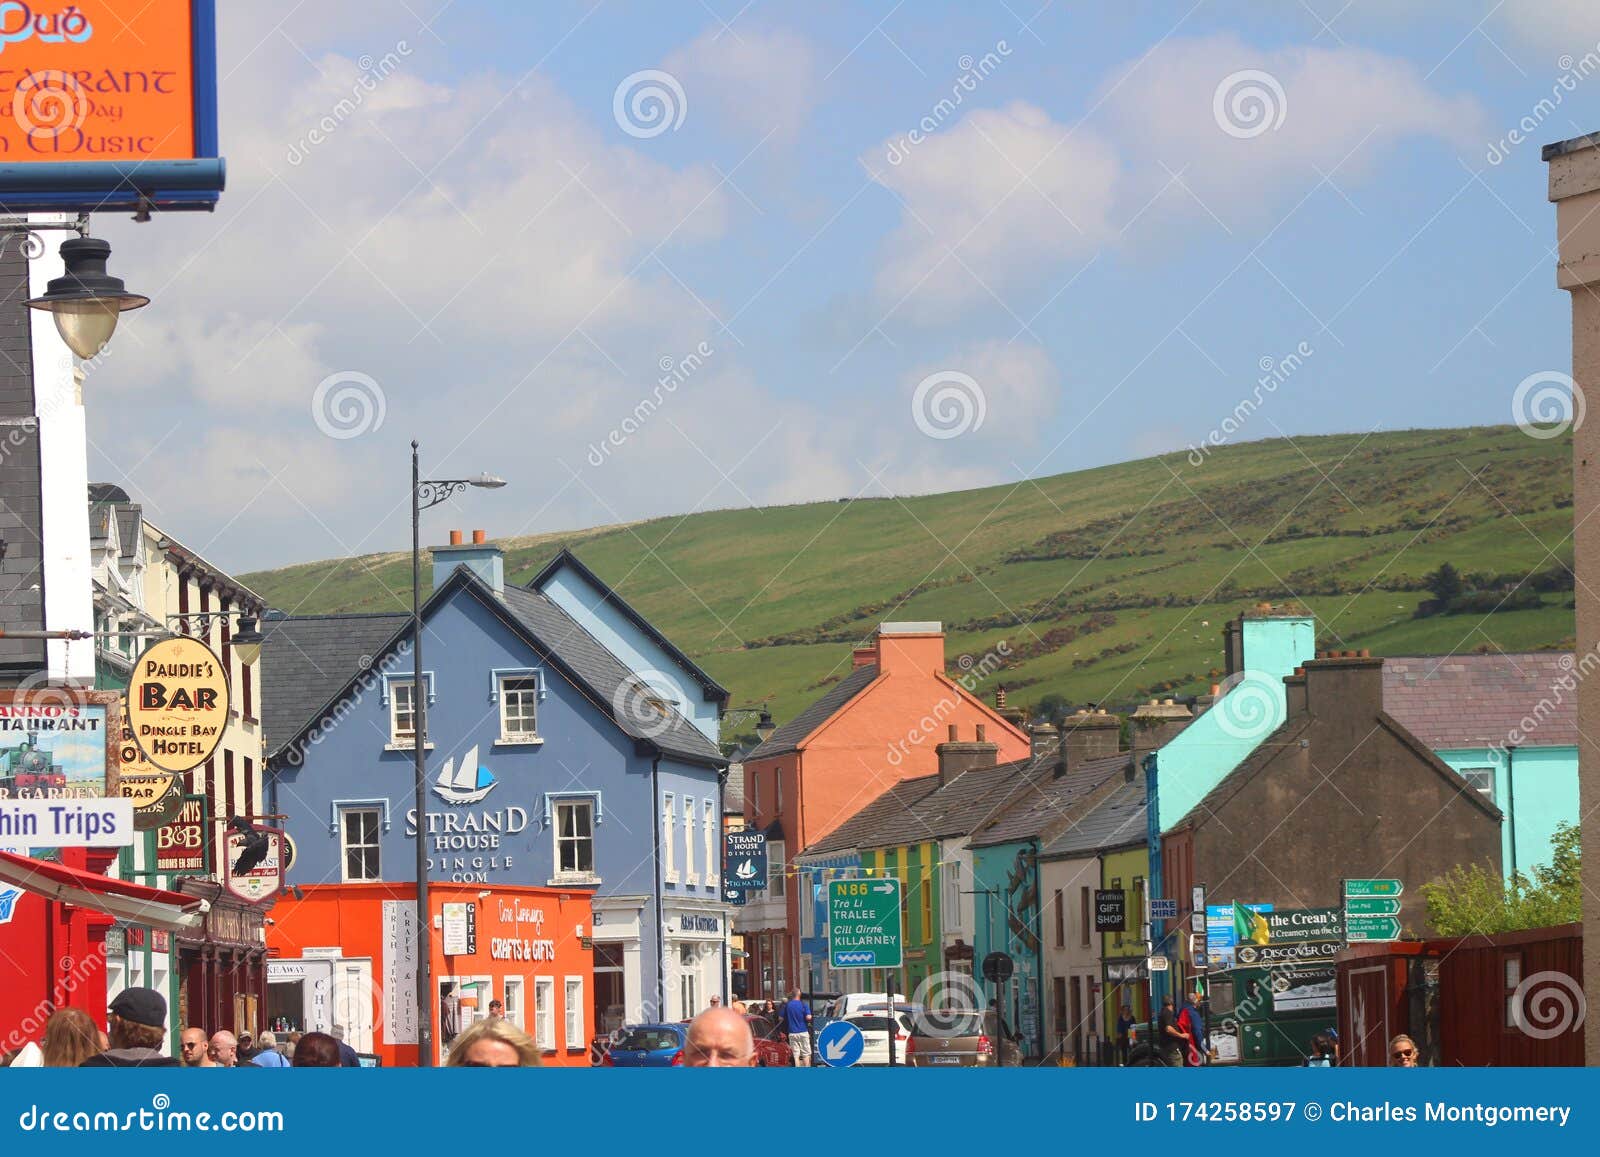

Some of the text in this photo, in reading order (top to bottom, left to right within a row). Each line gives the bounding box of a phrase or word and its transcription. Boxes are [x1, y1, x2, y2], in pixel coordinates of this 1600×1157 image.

[139, 682, 218, 711] BAR
[140, 724, 187, 737] DINGLE
[191, 724, 218, 737] BAY
[152, 739, 205, 756] HOTEL
[122, 787, 154, 798] BAR
[48, 806, 116, 841] Trips
[406, 806, 528, 836] STRAND
[157, 825, 202, 849] B&B
[435, 835, 500, 850] HOUSE
[728, 834, 764, 845] STRAND
[1099, 903, 1121, 913] GIFT
[1151, 900, 1176, 909] BIKE
[834, 910, 876, 920] TRALEE
[1097, 914, 1123, 924] SHOP
[1151, 909, 1177, 918] HIRE
[1270, 911, 1337, 927] the Crean's
[467, 903, 476, 955] GIFTS
[1276, 929, 1309, 938] Creamery
[834, 936, 896, 946] KILLARNEY
[491, 937, 555, 961] CRAFTS & GIFTS
[1261, 946, 1321, 958] DISCOVER
